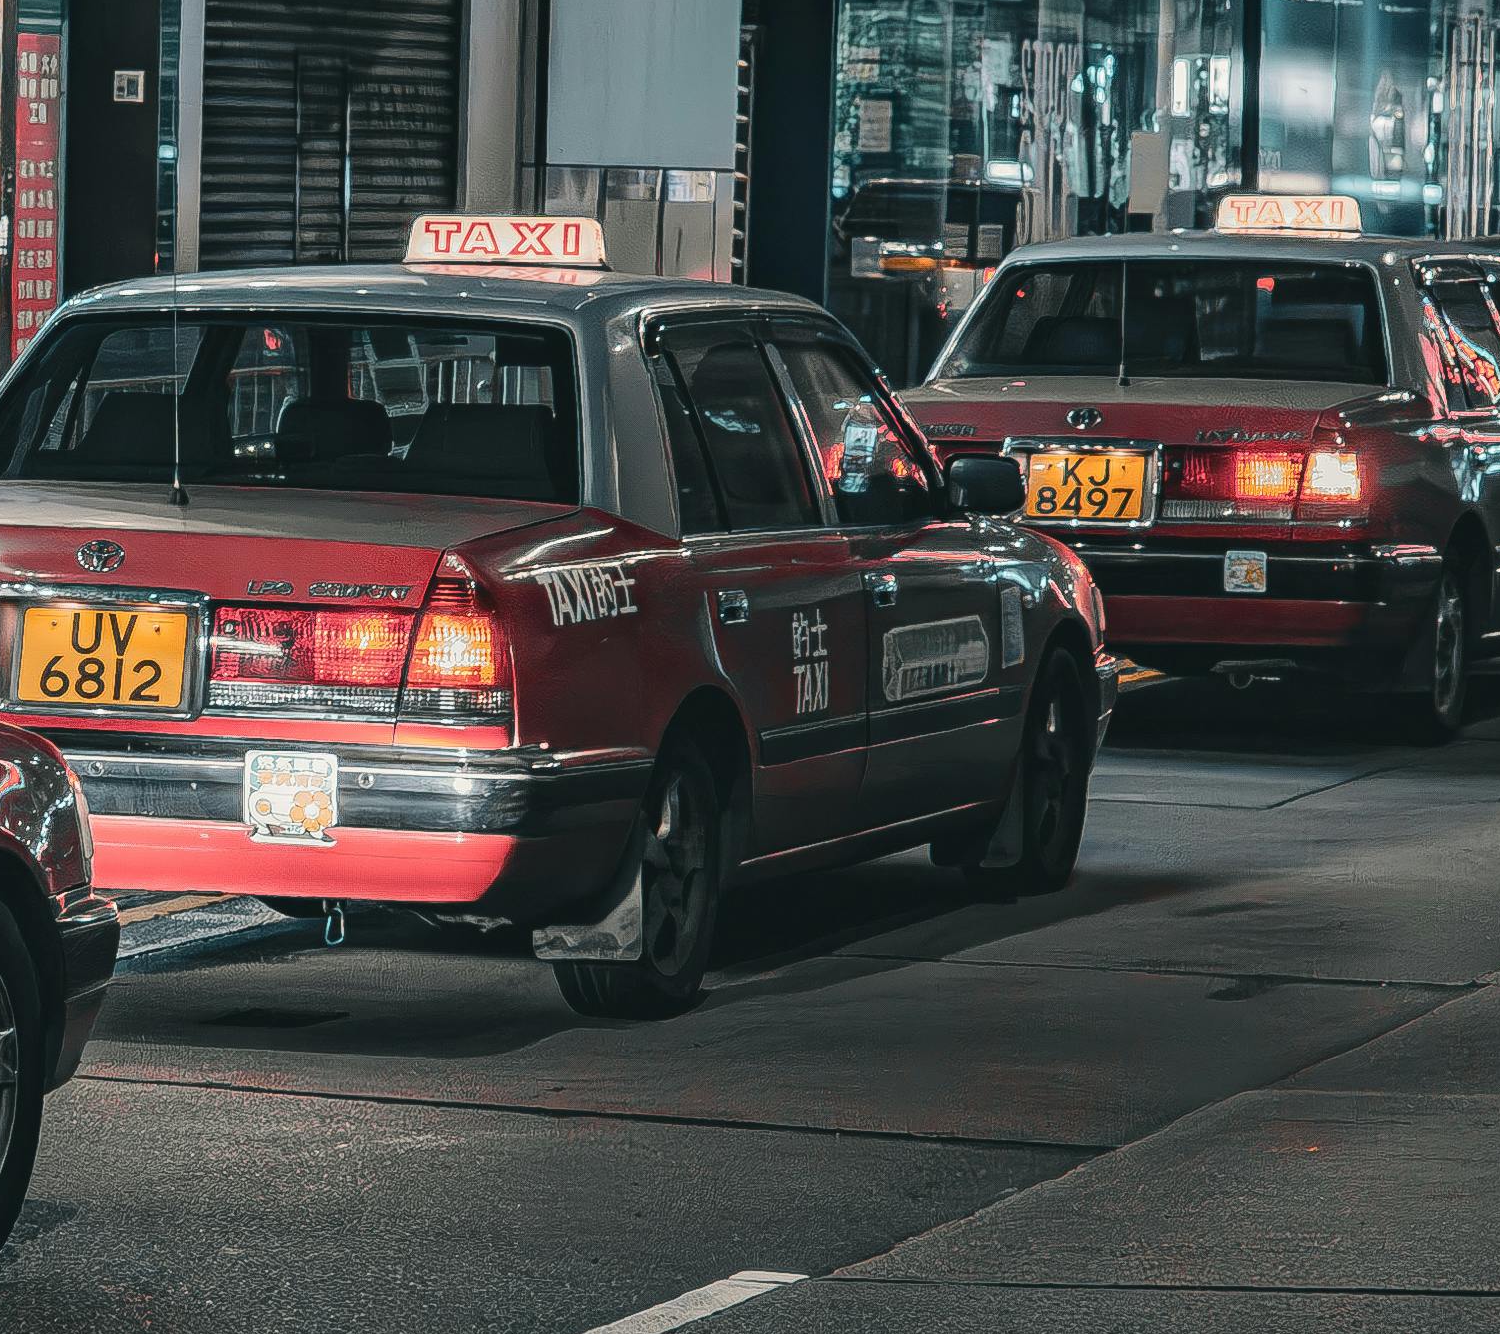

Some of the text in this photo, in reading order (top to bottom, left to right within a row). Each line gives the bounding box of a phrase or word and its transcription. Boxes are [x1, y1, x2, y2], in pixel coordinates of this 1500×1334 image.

[1228, 198, 1346, 225] TAXI
[425, 220, 581, 256] TAXI
[1062, 457, 1113, 486] KJ
[1035, 485, 1134, 519] 8497
[69, 612, 140, 657] UV
[792, 608, 829, 660] 的士
[39, 655, 162, 702] 6812
[793, 660, 830, 715] TAXI
